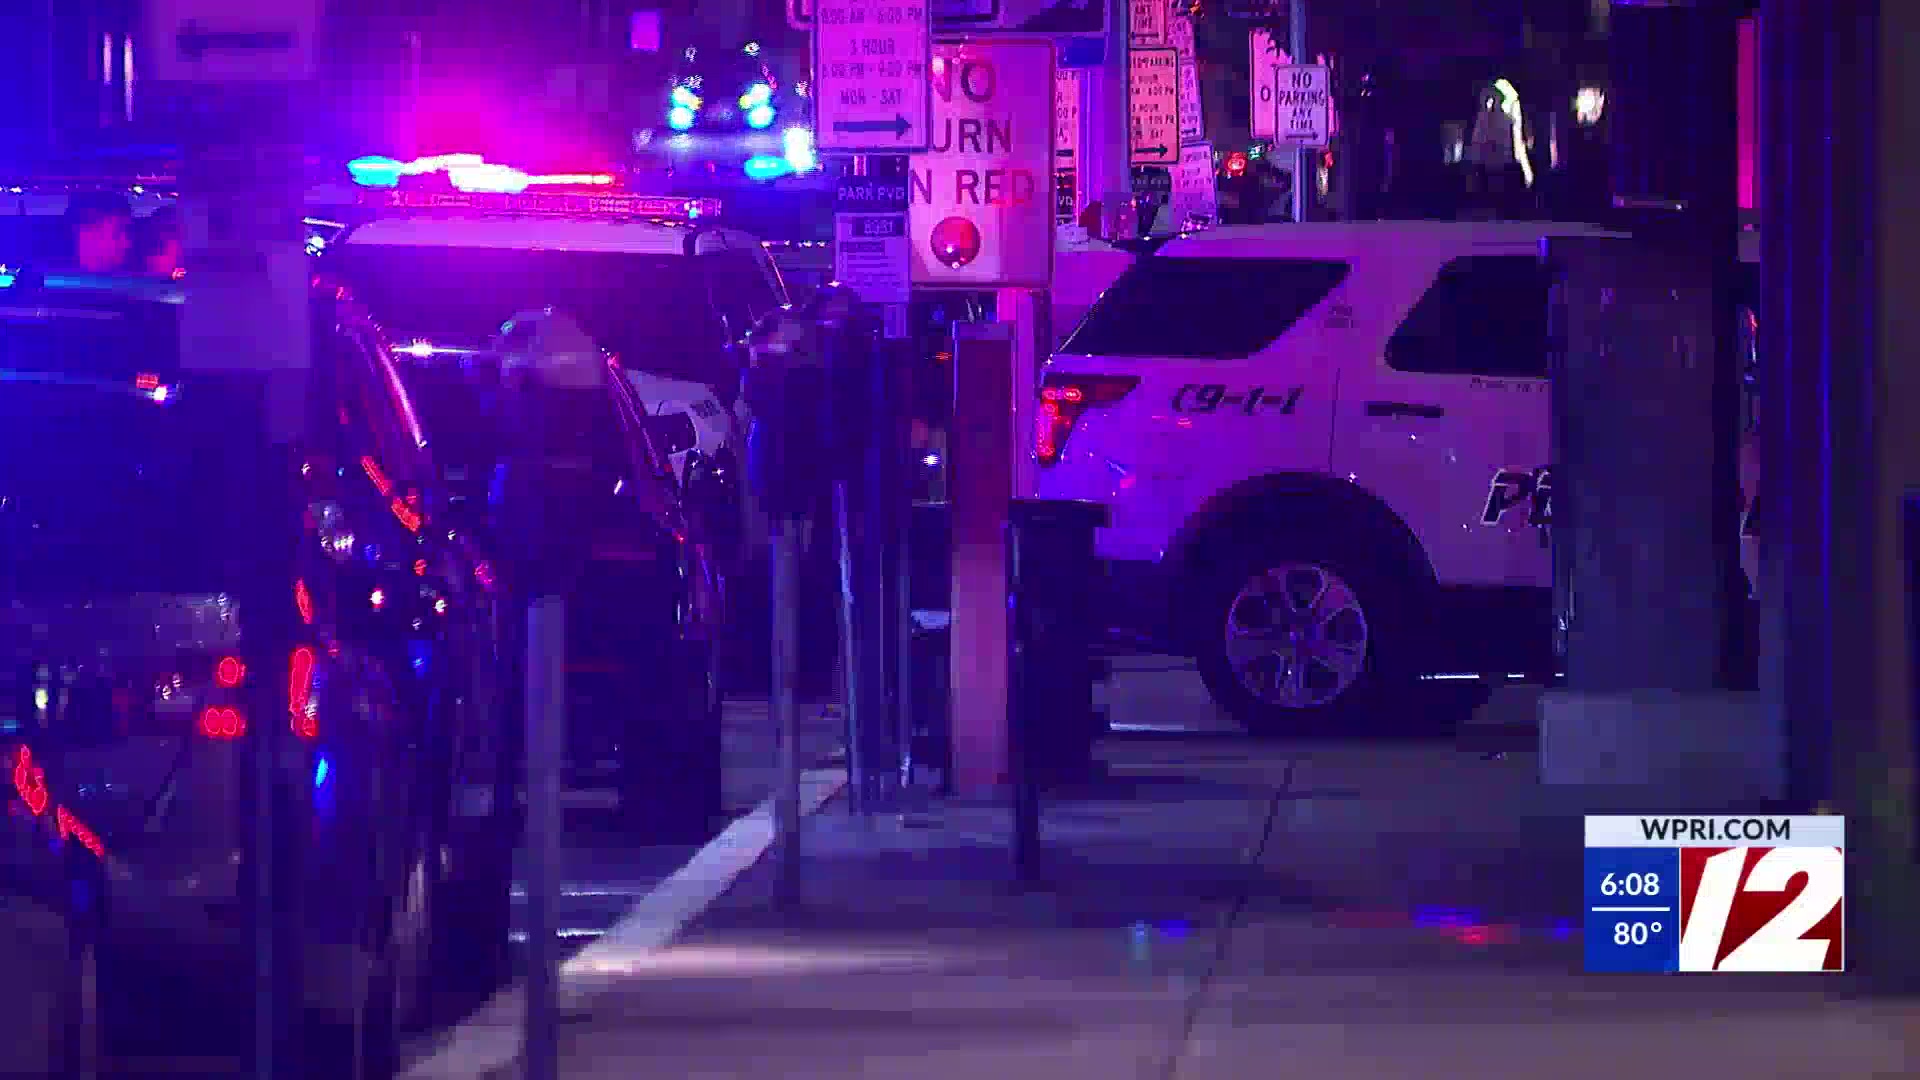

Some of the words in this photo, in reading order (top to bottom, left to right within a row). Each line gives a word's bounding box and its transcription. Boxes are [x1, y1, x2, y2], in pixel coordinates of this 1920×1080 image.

[862, 38, 895, 55] HOUR
[1291, 72, 1312, 88] NO
[841, 88, 866, 105] MON
[880, 88, 902, 105] SAT
[1279, 90, 1325, 106] PARKING
[1292, 108, 1312, 118] ANY
[1290, 120, 1313, 129] TIME
[931, 118, 1012, 153] URN
[838, 186, 873, 201] PARK
[956, 169, 1034, 205] RED
